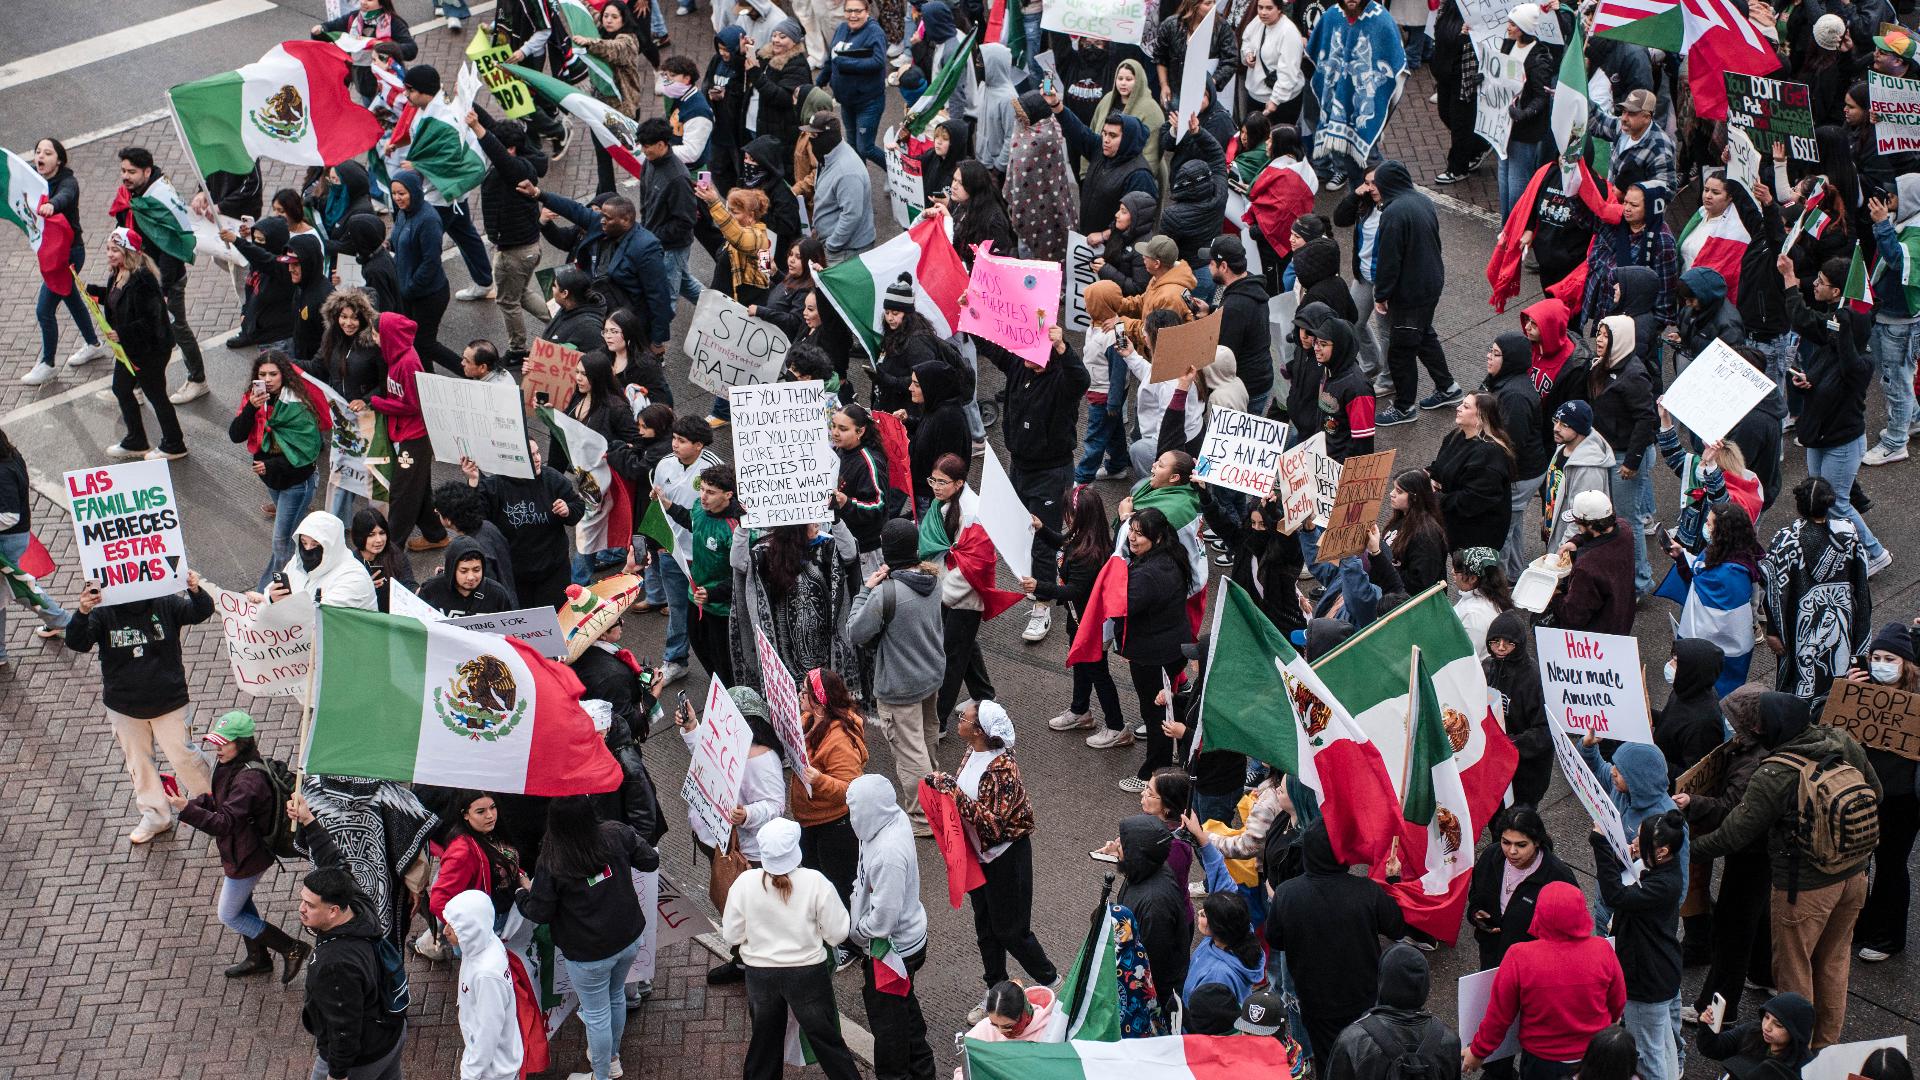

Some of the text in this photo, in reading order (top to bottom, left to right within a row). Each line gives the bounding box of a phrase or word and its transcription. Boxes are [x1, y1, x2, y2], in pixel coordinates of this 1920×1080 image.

[1062, 11, 1112, 36] GOES
[1480, 48, 1500, 78] NO
[1869, 72, 1920, 92] IF YOU TH
[981, 291, 1028, 323] FUERTES
[713, 309, 787, 362] STOP
[535, 338, 555, 360] NO
[560, 346, 579, 368] HU
[1713, 343, 1733, 363] THE
[697, 350, 768, 386] RAID
[1714, 363, 1735, 381] NOT
[732, 387, 826, 407] IF YOU THINK
[733, 407, 827, 428] YOU LOVE FREEDOM
[1207, 409, 1286, 447] MIGRATION
[738, 431, 761, 447] BUT
[765, 430, 787, 445] YOU
[742, 443, 816, 463] CARE IF IT
[1207, 437, 1281, 470] IS AN ACT
[740, 459, 817, 479] APPLIES TO
[1220, 464, 1276, 494] COURAGE
[1316, 453, 1342, 481] DENY
[68, 470, 113, 498] LAS
[738, 473, 831, 496] EVERYONE WHAT
[1288, 472, 1310, 495] Famili
[1315, 474, 1338, 499] DEFE
[73, 487, 168, 522] FAMILIAS
[739, 497, 760, 509] YOU
[762, 491, 809, 508] ACTUALLY
[1284, 492, 1313, 525] Togeth
[746, 512, 761, 525] IS
[1342, 501, 1368, 528] NOT
[82, 509, 178, 546] MERECES
[103, 534, 167, 562] ESTAR
[223, 616, 303, 647] Chingue
[500, 616, 528, 627] FOR
[576, 607, 616, 638] VIVA
[512, 628, 554, 641] FAMILY
[1564, 631, 1604, 660] Hate
[229, 641, 243, 660] A
[237, 665, 271, 685] La
[1546, 659, 1623, 690] Never made
[1562, 688, 1616, 707] America
[1841, 683, 1920, 717] PEOPL
[1566, 707, 1609, 731] Great
[1857, 706, 1904, 729] OVER
